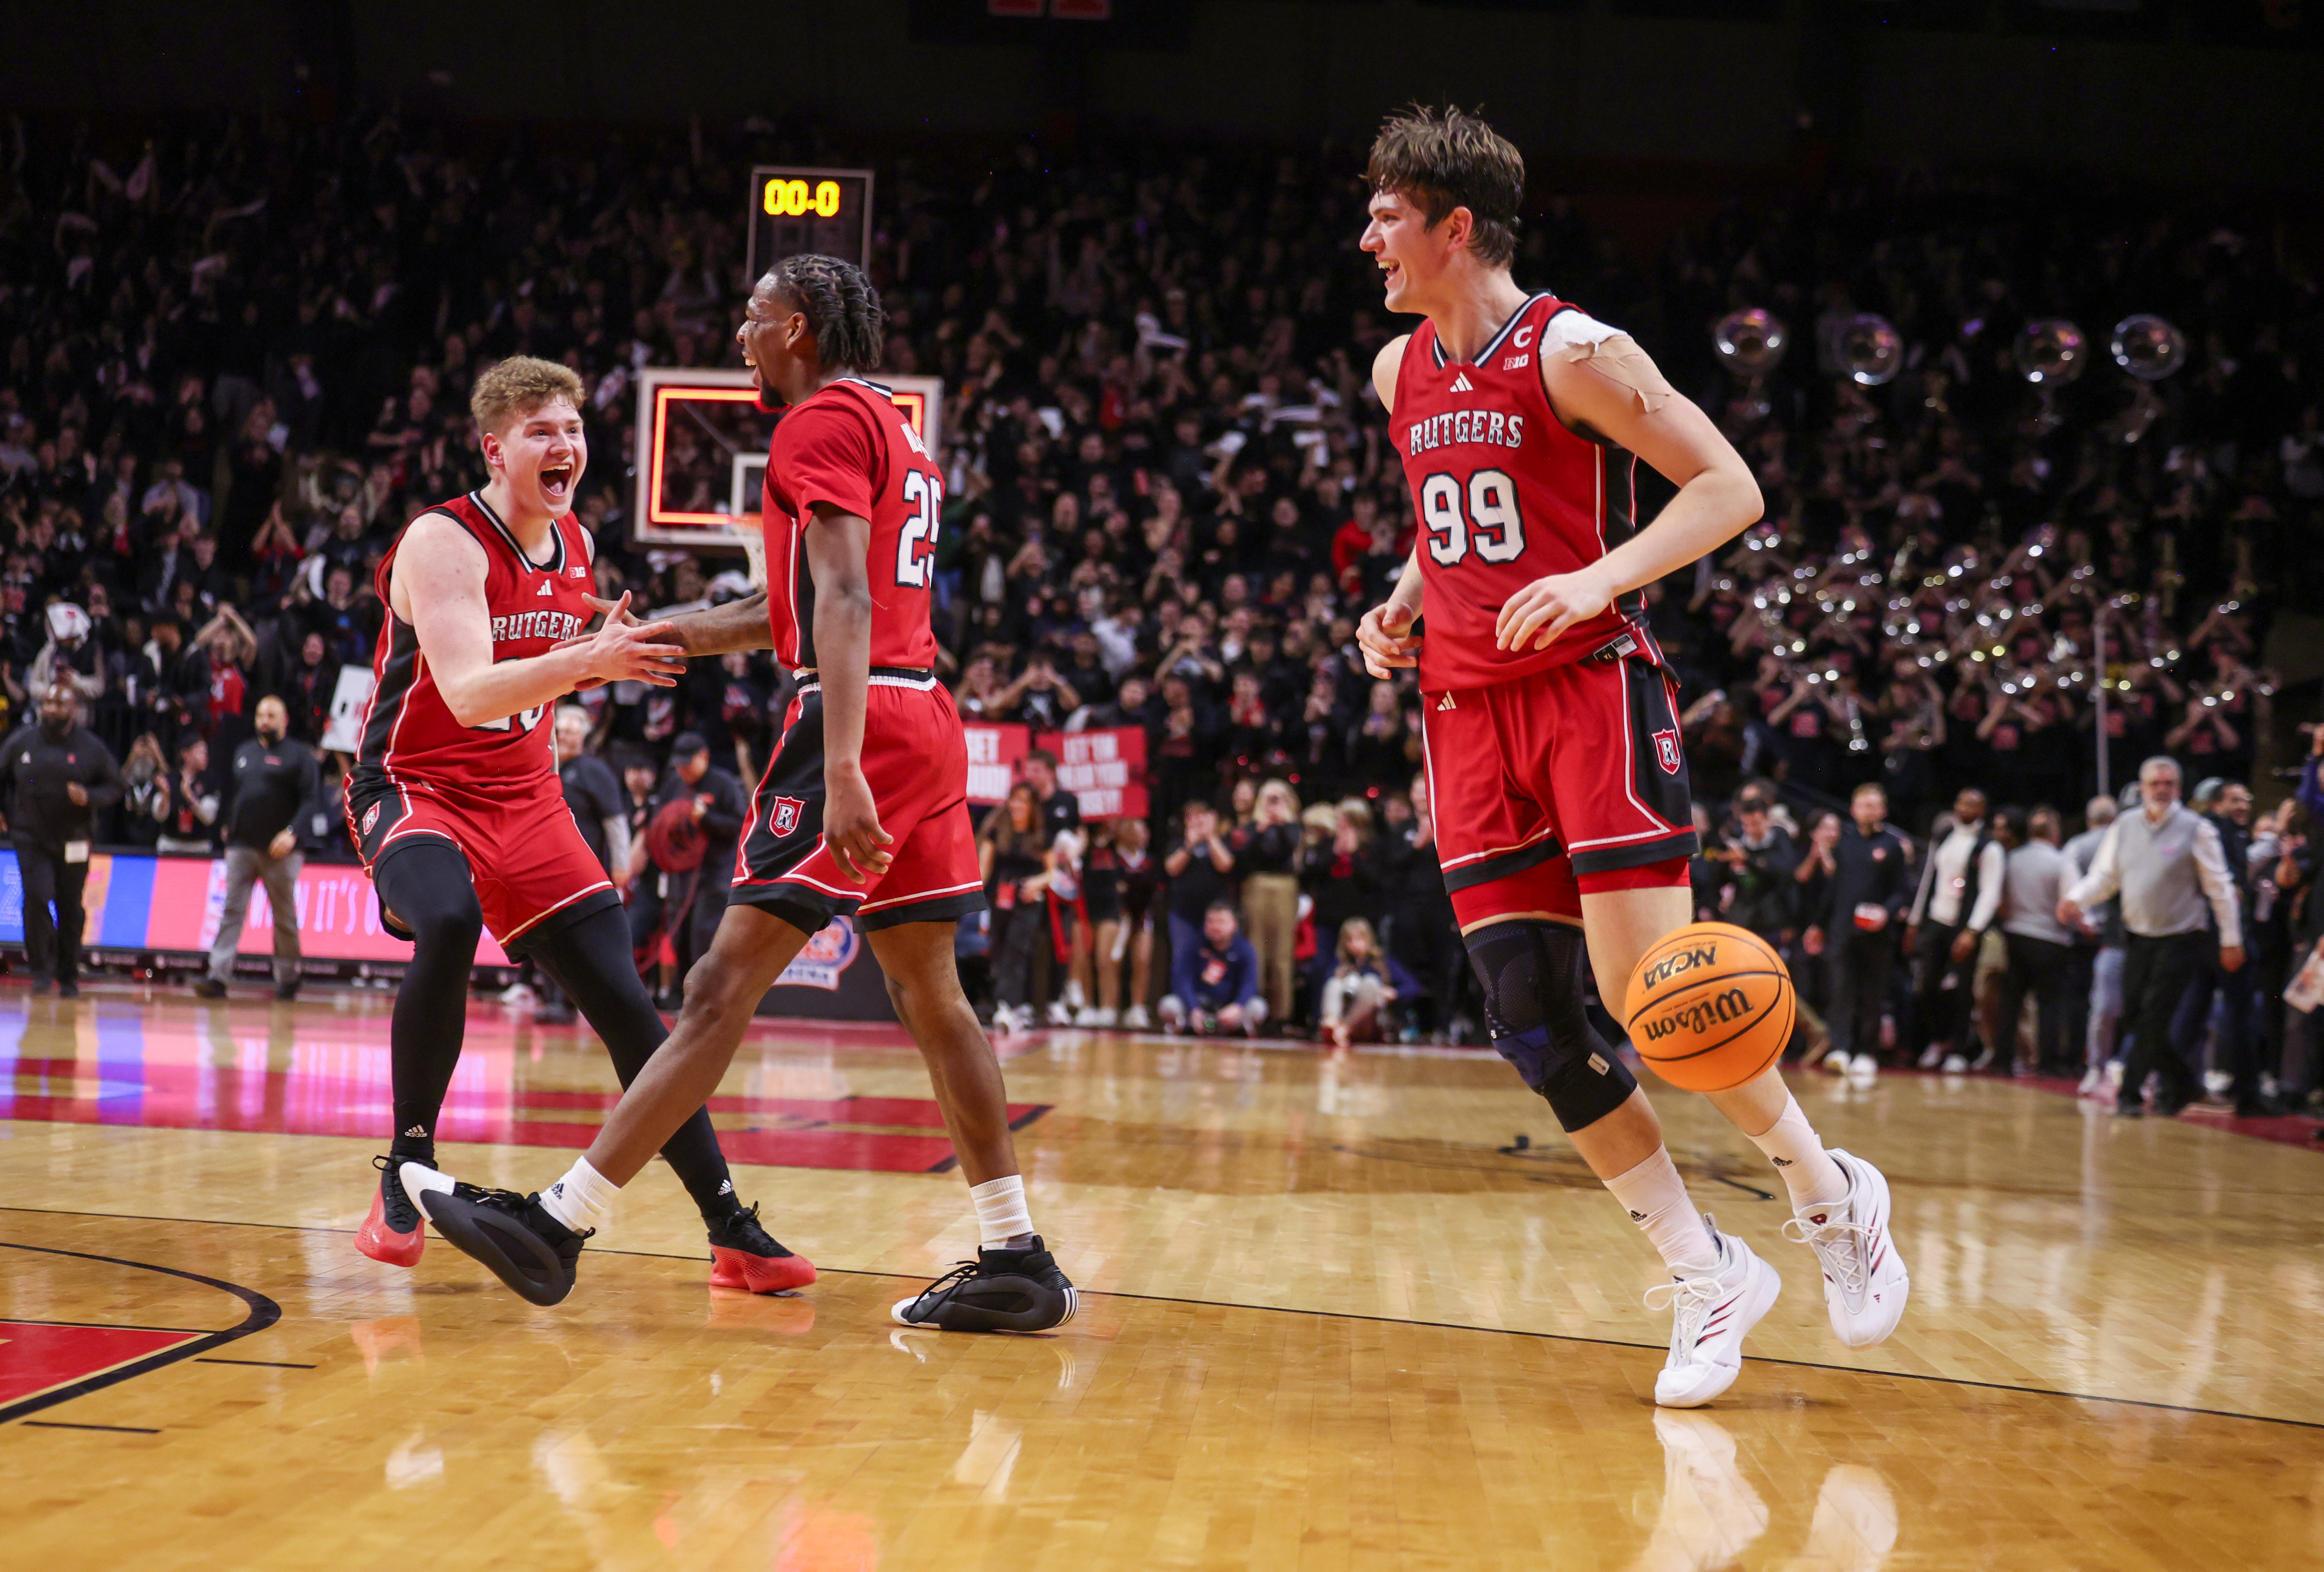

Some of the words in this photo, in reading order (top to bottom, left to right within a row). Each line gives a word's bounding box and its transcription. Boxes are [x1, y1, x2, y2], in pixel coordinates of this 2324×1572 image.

[1513, 325, 1533, 348] C
[1410, 410, 1524, 456] RUTGERS
[1420, 467, 1528, 569] 99
[491, 610, 583, 642] RUTGERS
[1658, 738, 1679, 766] R
[774, 803, 795, 831] R
[1644, 945, 1718, 991] NCAA
[1643, 987, 1754, 1041] Wilson
